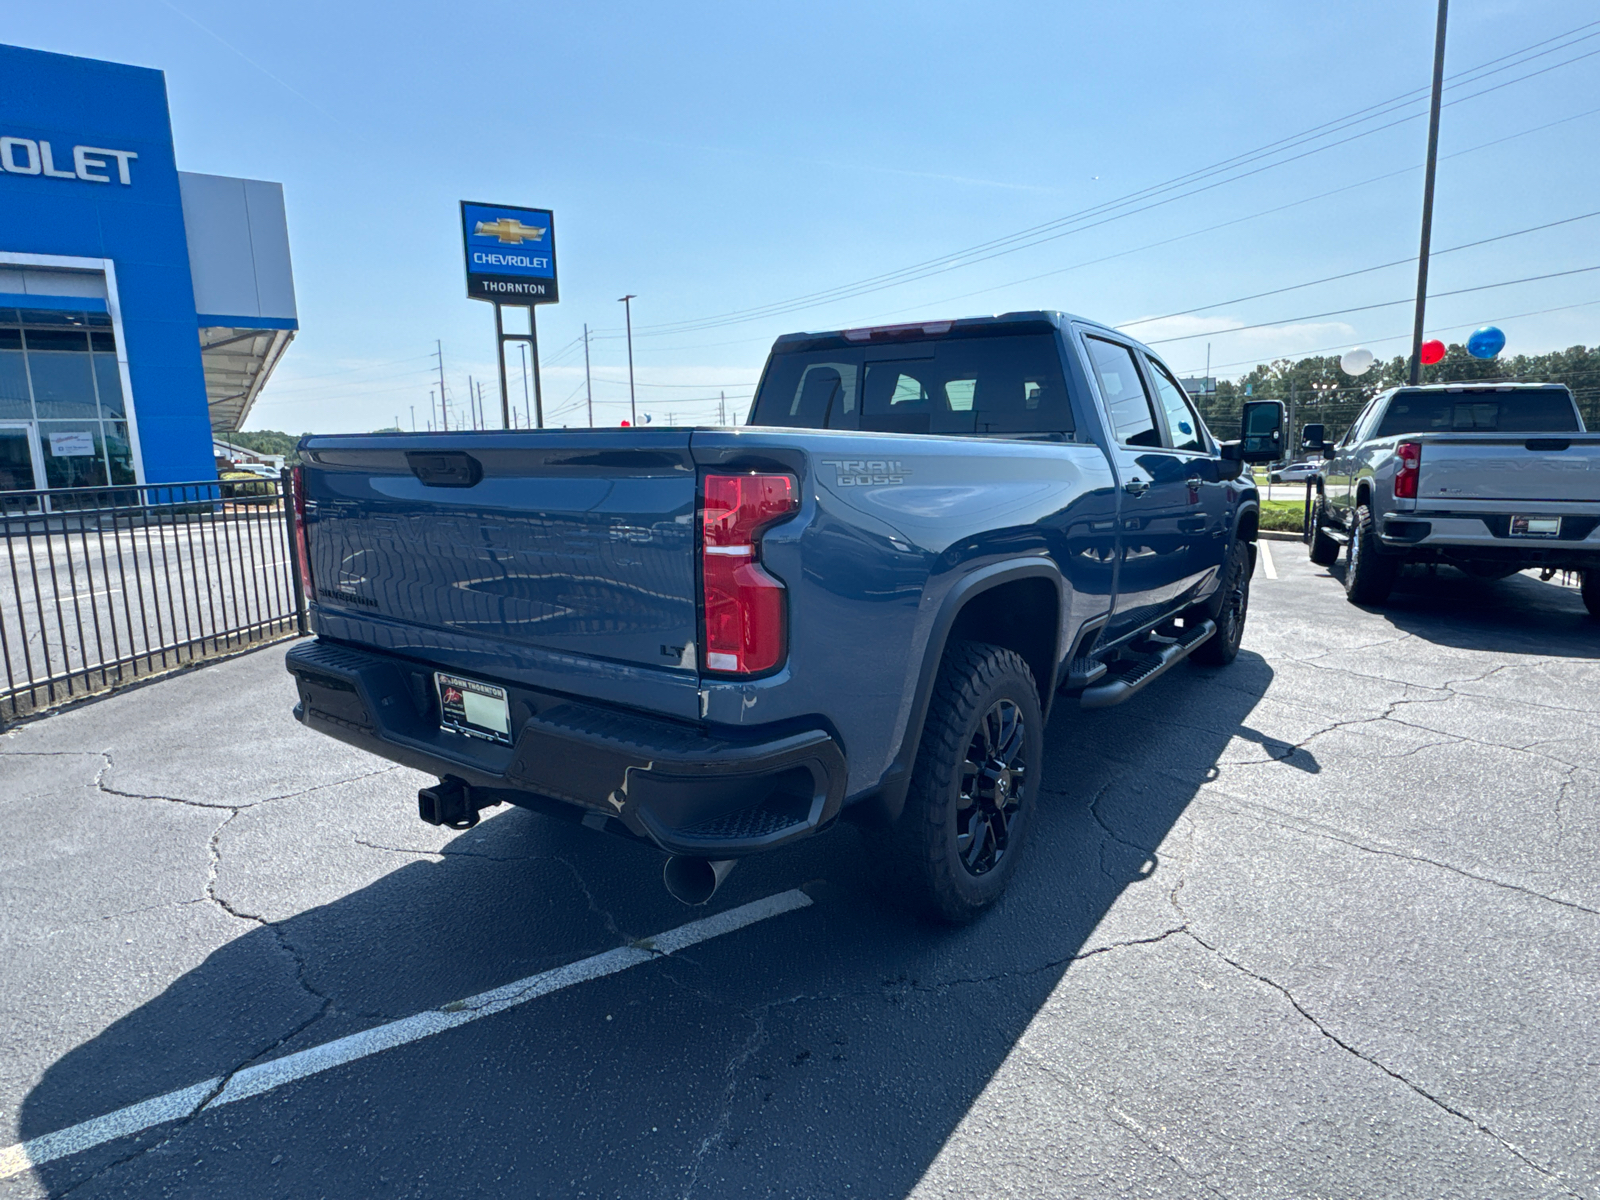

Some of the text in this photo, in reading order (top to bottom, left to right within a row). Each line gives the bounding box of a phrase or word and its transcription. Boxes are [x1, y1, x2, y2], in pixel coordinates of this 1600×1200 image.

[0, 136, 138, 185] OLET
[473, 252, 548, 268] CHEVROLET
[482, 281, 545, 295] THORNTON
[821, 460, 913, 475] TRAIL
[837, 474, 904, 487] BOSS
[660, 644, 685, 658] LT
[451, 678, 467, 688] JOHN
[468, 682, 502, 697] THORNTON
